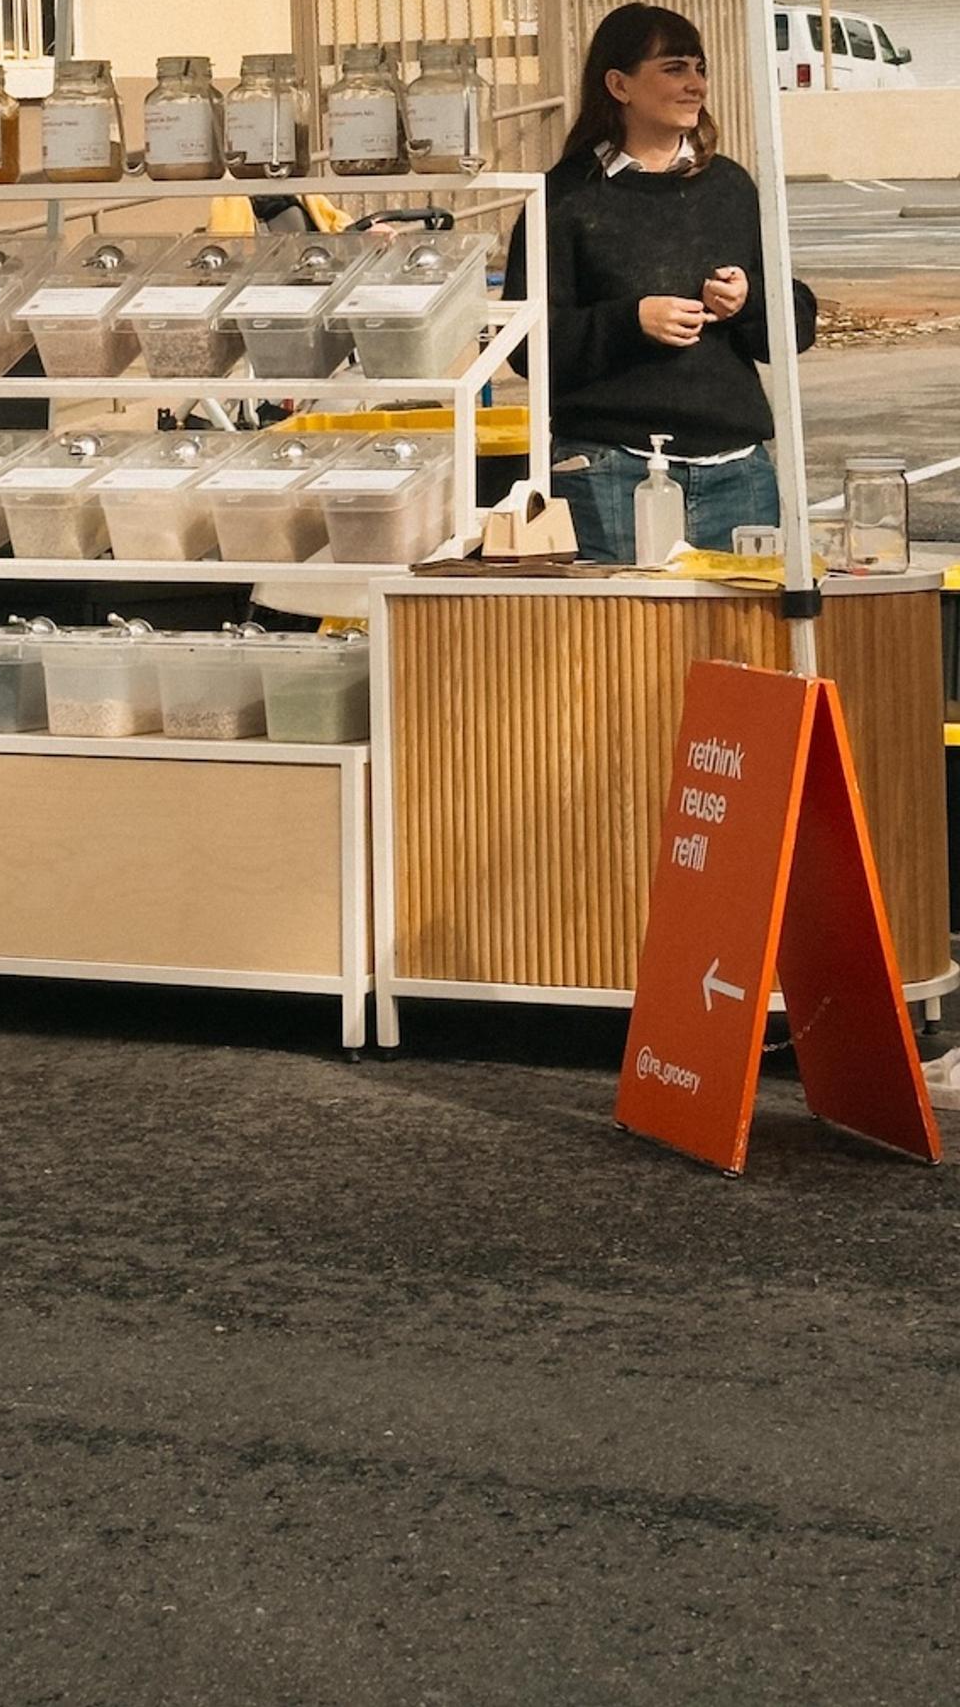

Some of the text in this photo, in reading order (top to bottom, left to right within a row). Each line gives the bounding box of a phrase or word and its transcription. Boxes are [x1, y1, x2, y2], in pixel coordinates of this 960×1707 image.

[687, 737, 746, 780] rethink
[679, 785, 727, 824] reuse
[671, 833, 709, 872] refill
